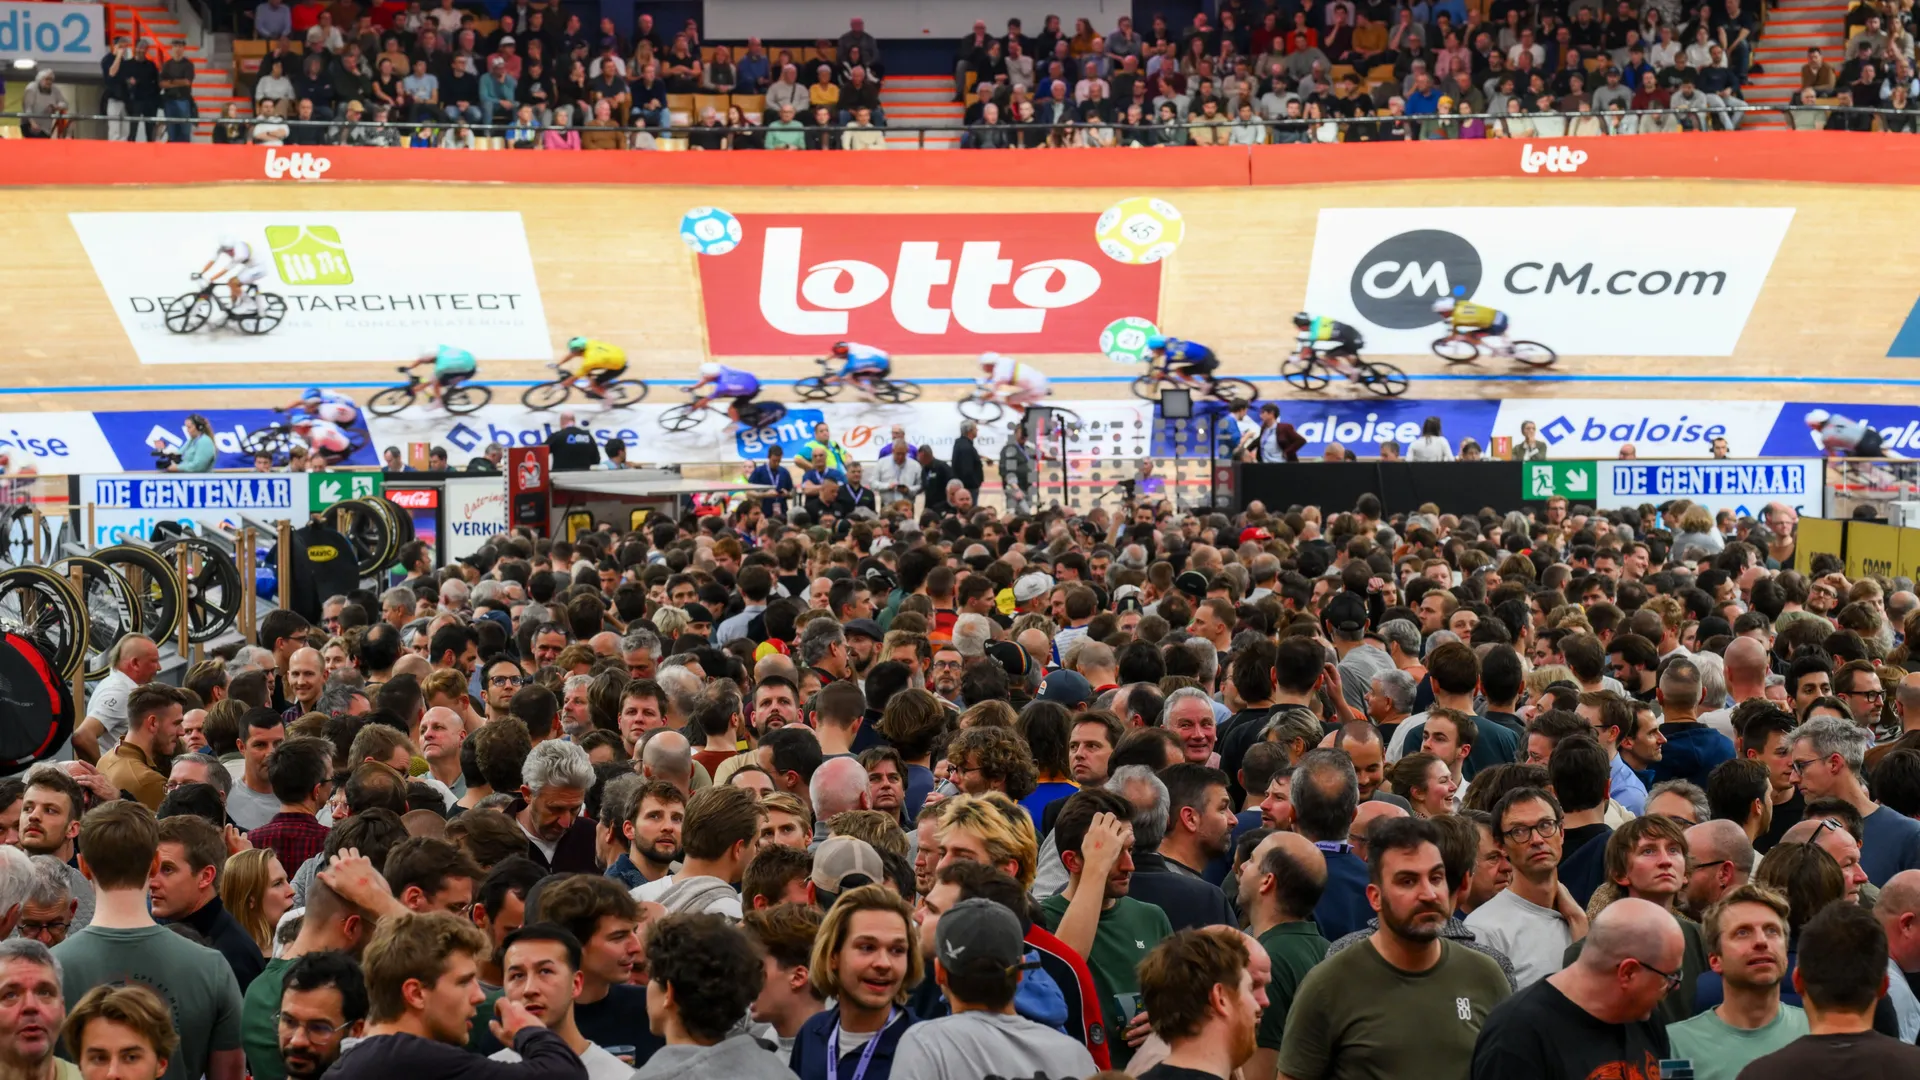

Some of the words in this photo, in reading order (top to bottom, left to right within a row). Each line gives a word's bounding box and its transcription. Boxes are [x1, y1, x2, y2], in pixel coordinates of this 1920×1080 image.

[264, 148, 331, 178] lotto
[1520, 143, 1588, 173] lotto
[759, 227, 1101, 335] lotto
[1504, 261, 1727, 296] CM.com
[1297, 412, 1421, 444] aloise
[1581, 415, 1726, 442] baloise
[98, 480, 130, 508] DE
[140, 479, 291, 508] GENTENAAR
[1615, 467, 1647, 494] DE
[1656, 466, 1804, 494] GENTENAAR
